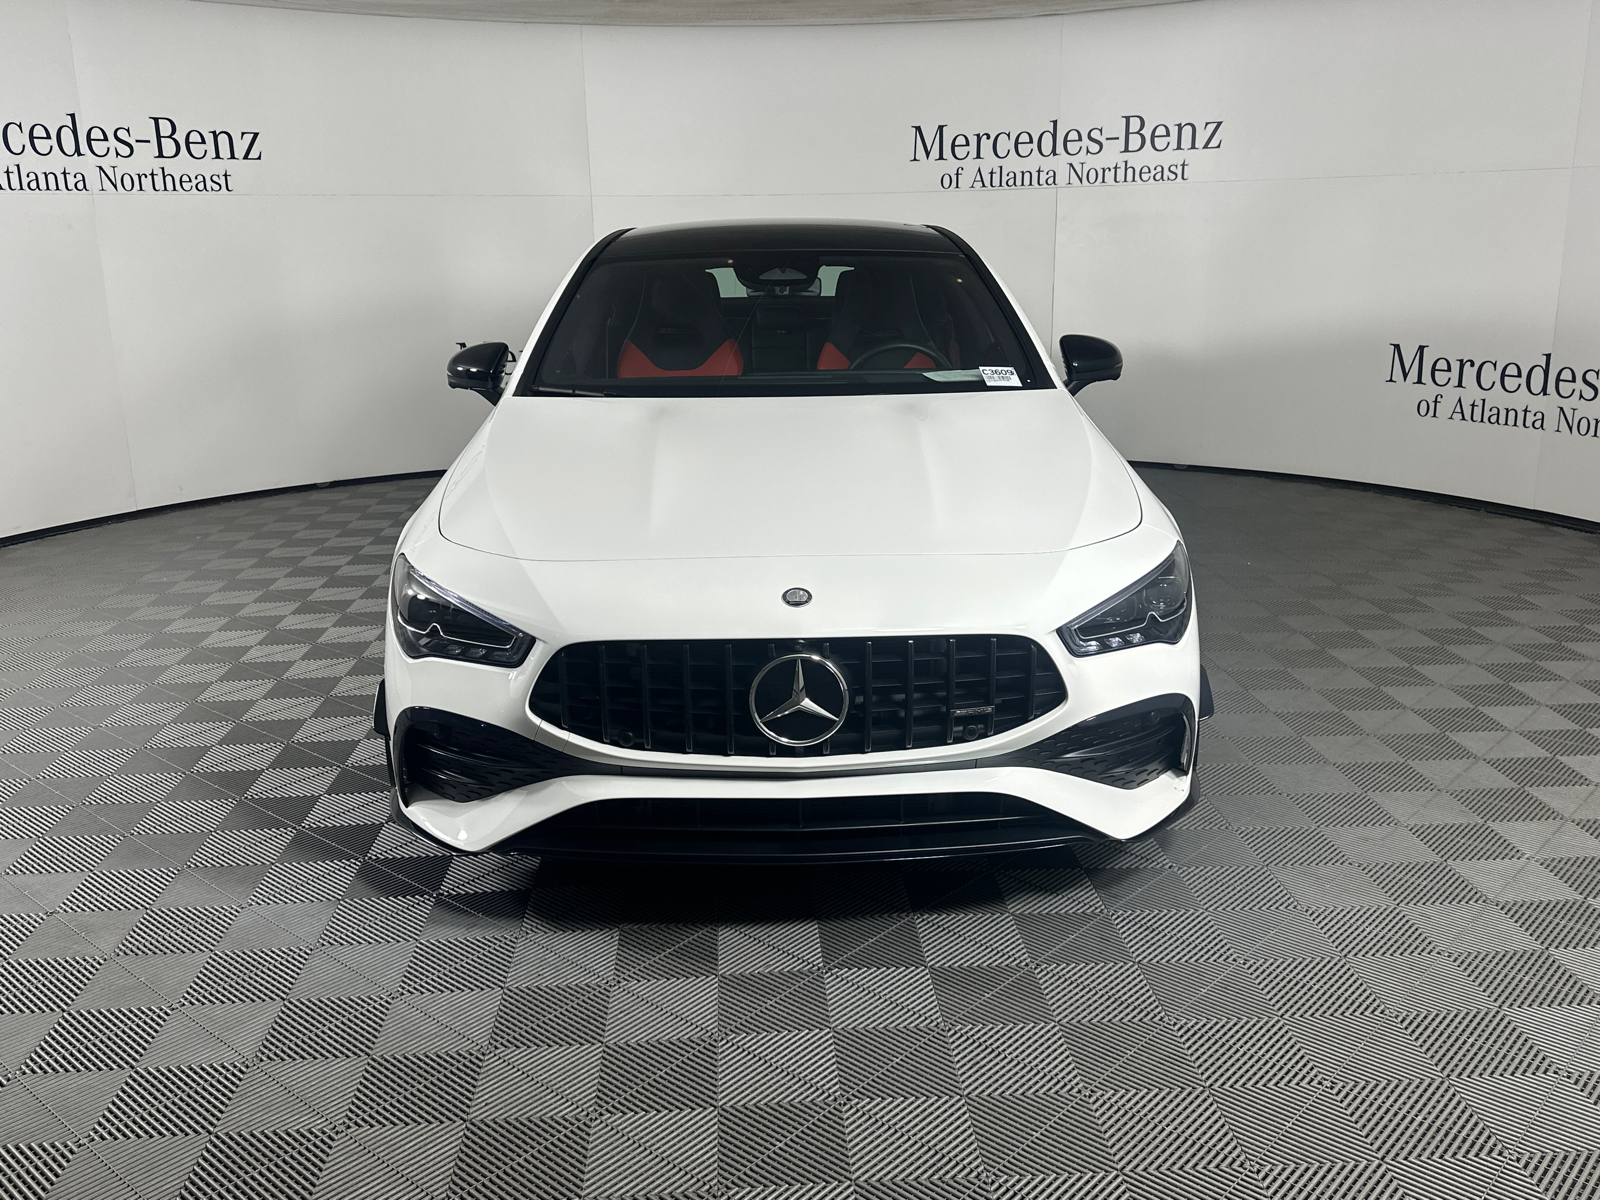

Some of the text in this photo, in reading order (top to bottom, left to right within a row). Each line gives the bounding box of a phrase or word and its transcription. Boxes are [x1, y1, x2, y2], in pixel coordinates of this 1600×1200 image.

[909, 115, 1224, 162] Mercedes-Benz
[0, 164, 234, 192] tlanta Northeast
[940, 159, 1189, 190] of Atlanta Northeast
[1385, 343, 1600, 402] Mercedes
[1416, 393, 1600, 439] of Atlanta Nor
